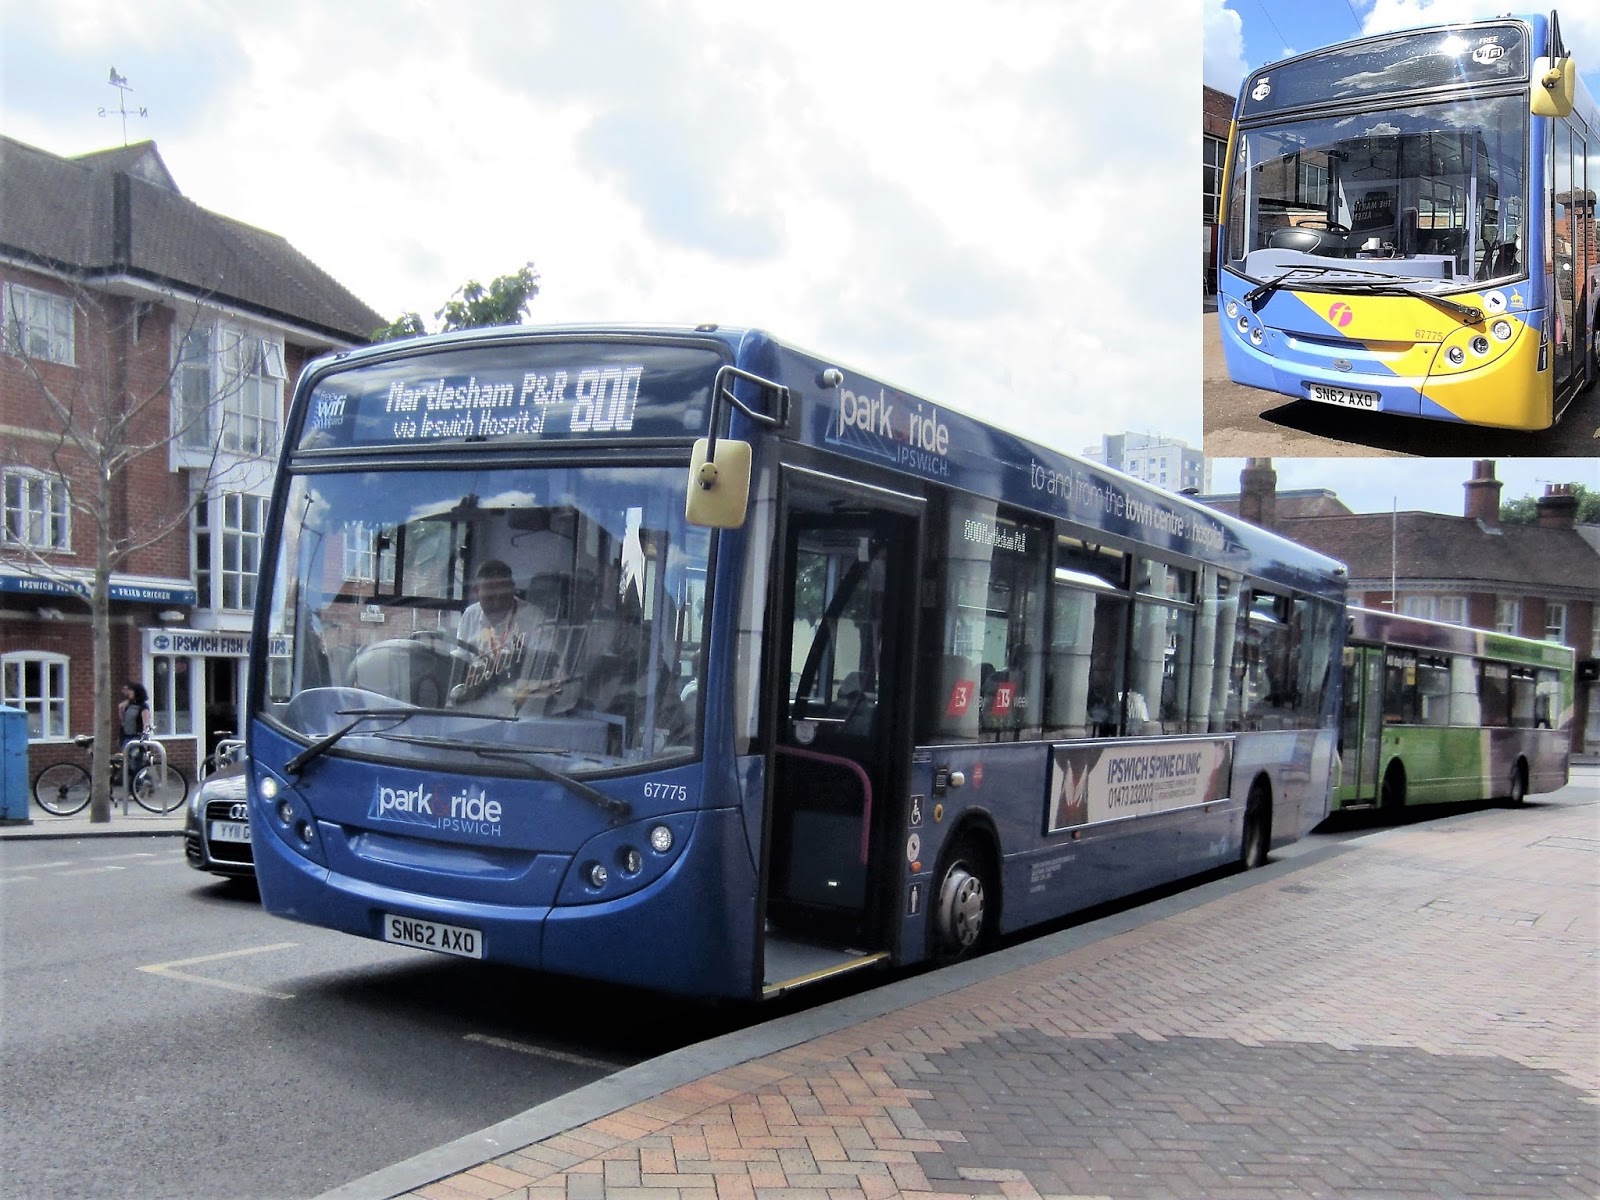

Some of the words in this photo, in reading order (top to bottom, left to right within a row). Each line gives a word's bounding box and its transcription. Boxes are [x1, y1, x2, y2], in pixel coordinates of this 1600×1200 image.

[1479, 36, 1499, 45] FREE
[1414, 329, 1443, 341] 67775
[318, 394, 347, 417] wifi
[386, 377, 515, 413] Martlesham
[520, 371, 568, 406] P&R
[570, 367, 644, 432] 800
[1315, 387, 1345, 403] SN62
[1349, 393, 1373, 407] AXO
[393, 415, 416, 438] via
[420, 410, 474, 438] Ipswich
[480, 407, 547, 436] Hospital
[840, 388, 893, 439] park
[910, 404, 949, 455] ride
[896, 445, 948, 476] IPSWICH
[1031, 460, 1045, 490] to
[1047, 469, 1072, 498] and
[1076, 471, 1103, 505] from
[1104, 484, 1125, 516] the
[1125, 493, 1153, 527] town
[1154, 506, 1184, 536] centre
[1193, 515, 1225, 551] hospital
[964, 519, 982, 542] 800
[19, 580, 53, 591] IPSWICH
[119, 588, 140, 598] FRIED
[142, 589, 171, 600] CHICKEN
[173, 635, 218, 652] IPSWICH
[221, 637, 243, 653] FISH
[1108, 756, 1149, 784] IPSWICH
[1149, 755, 1175, 779] SPINE
[1175, 752, 1202, 776] CLINIC
[380, 783, 432, 816] park
[451, 789, 502, 822] ride
[644, 782, 687, 801] 67775
[1109, 785, 1129, 809] 01473
[438, 818, 501, 836] IPSWICH
[392, 919, 435, 946] SN62
[442, 928, 474, 953] AXO
